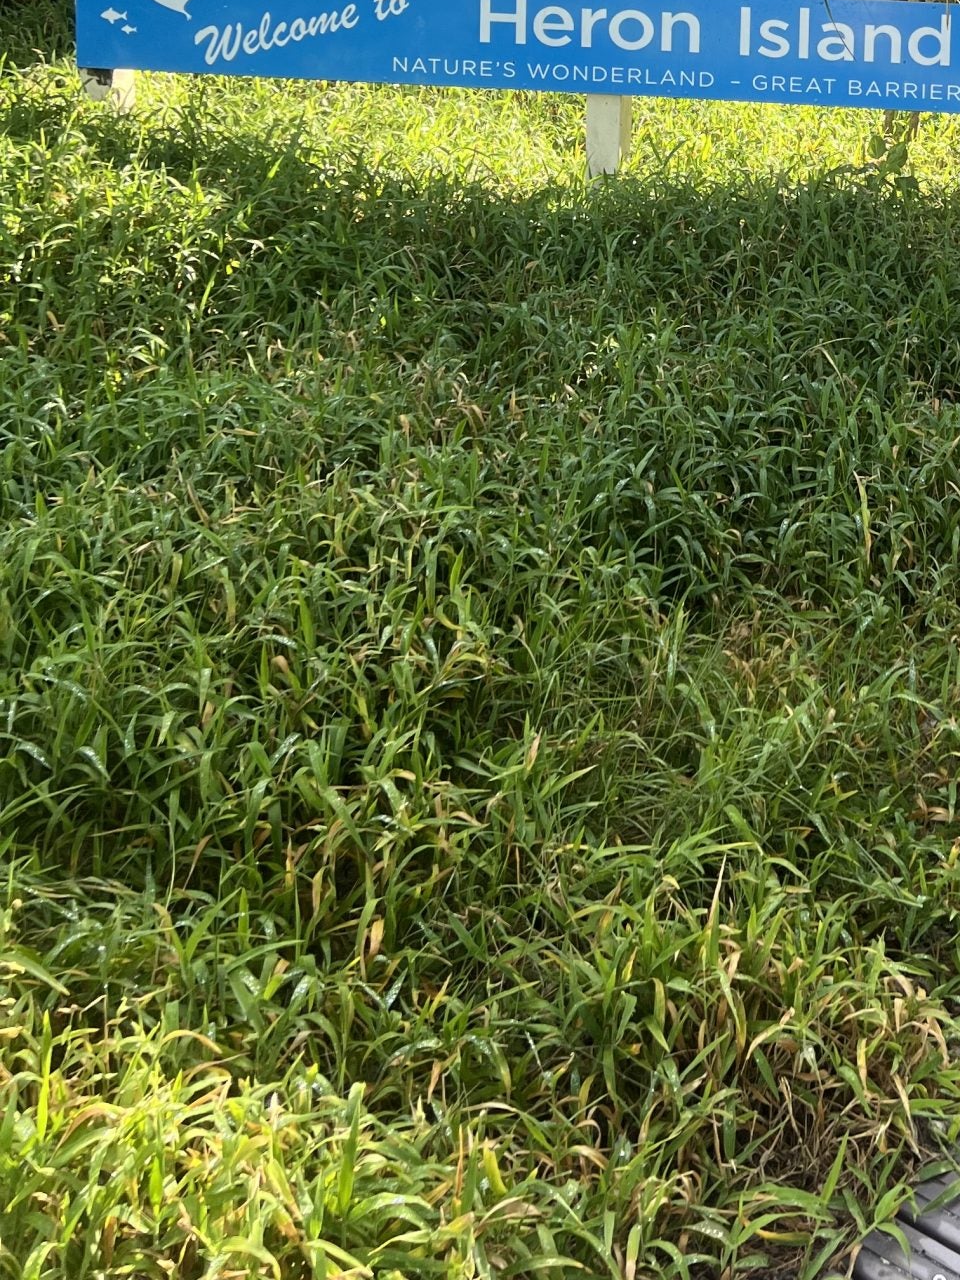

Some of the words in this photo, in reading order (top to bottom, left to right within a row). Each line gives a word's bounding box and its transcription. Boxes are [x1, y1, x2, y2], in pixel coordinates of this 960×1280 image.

[194, 3, 360, 65] Welcome
[739, 5, 951, 66] Island
[393, 56, 516, 78] NATURE'S
[526, 63, 714, 88] WONDERLAND
[752, 74, 836, 94] GREAT
[848, 79, 960, 101] BARRIER
